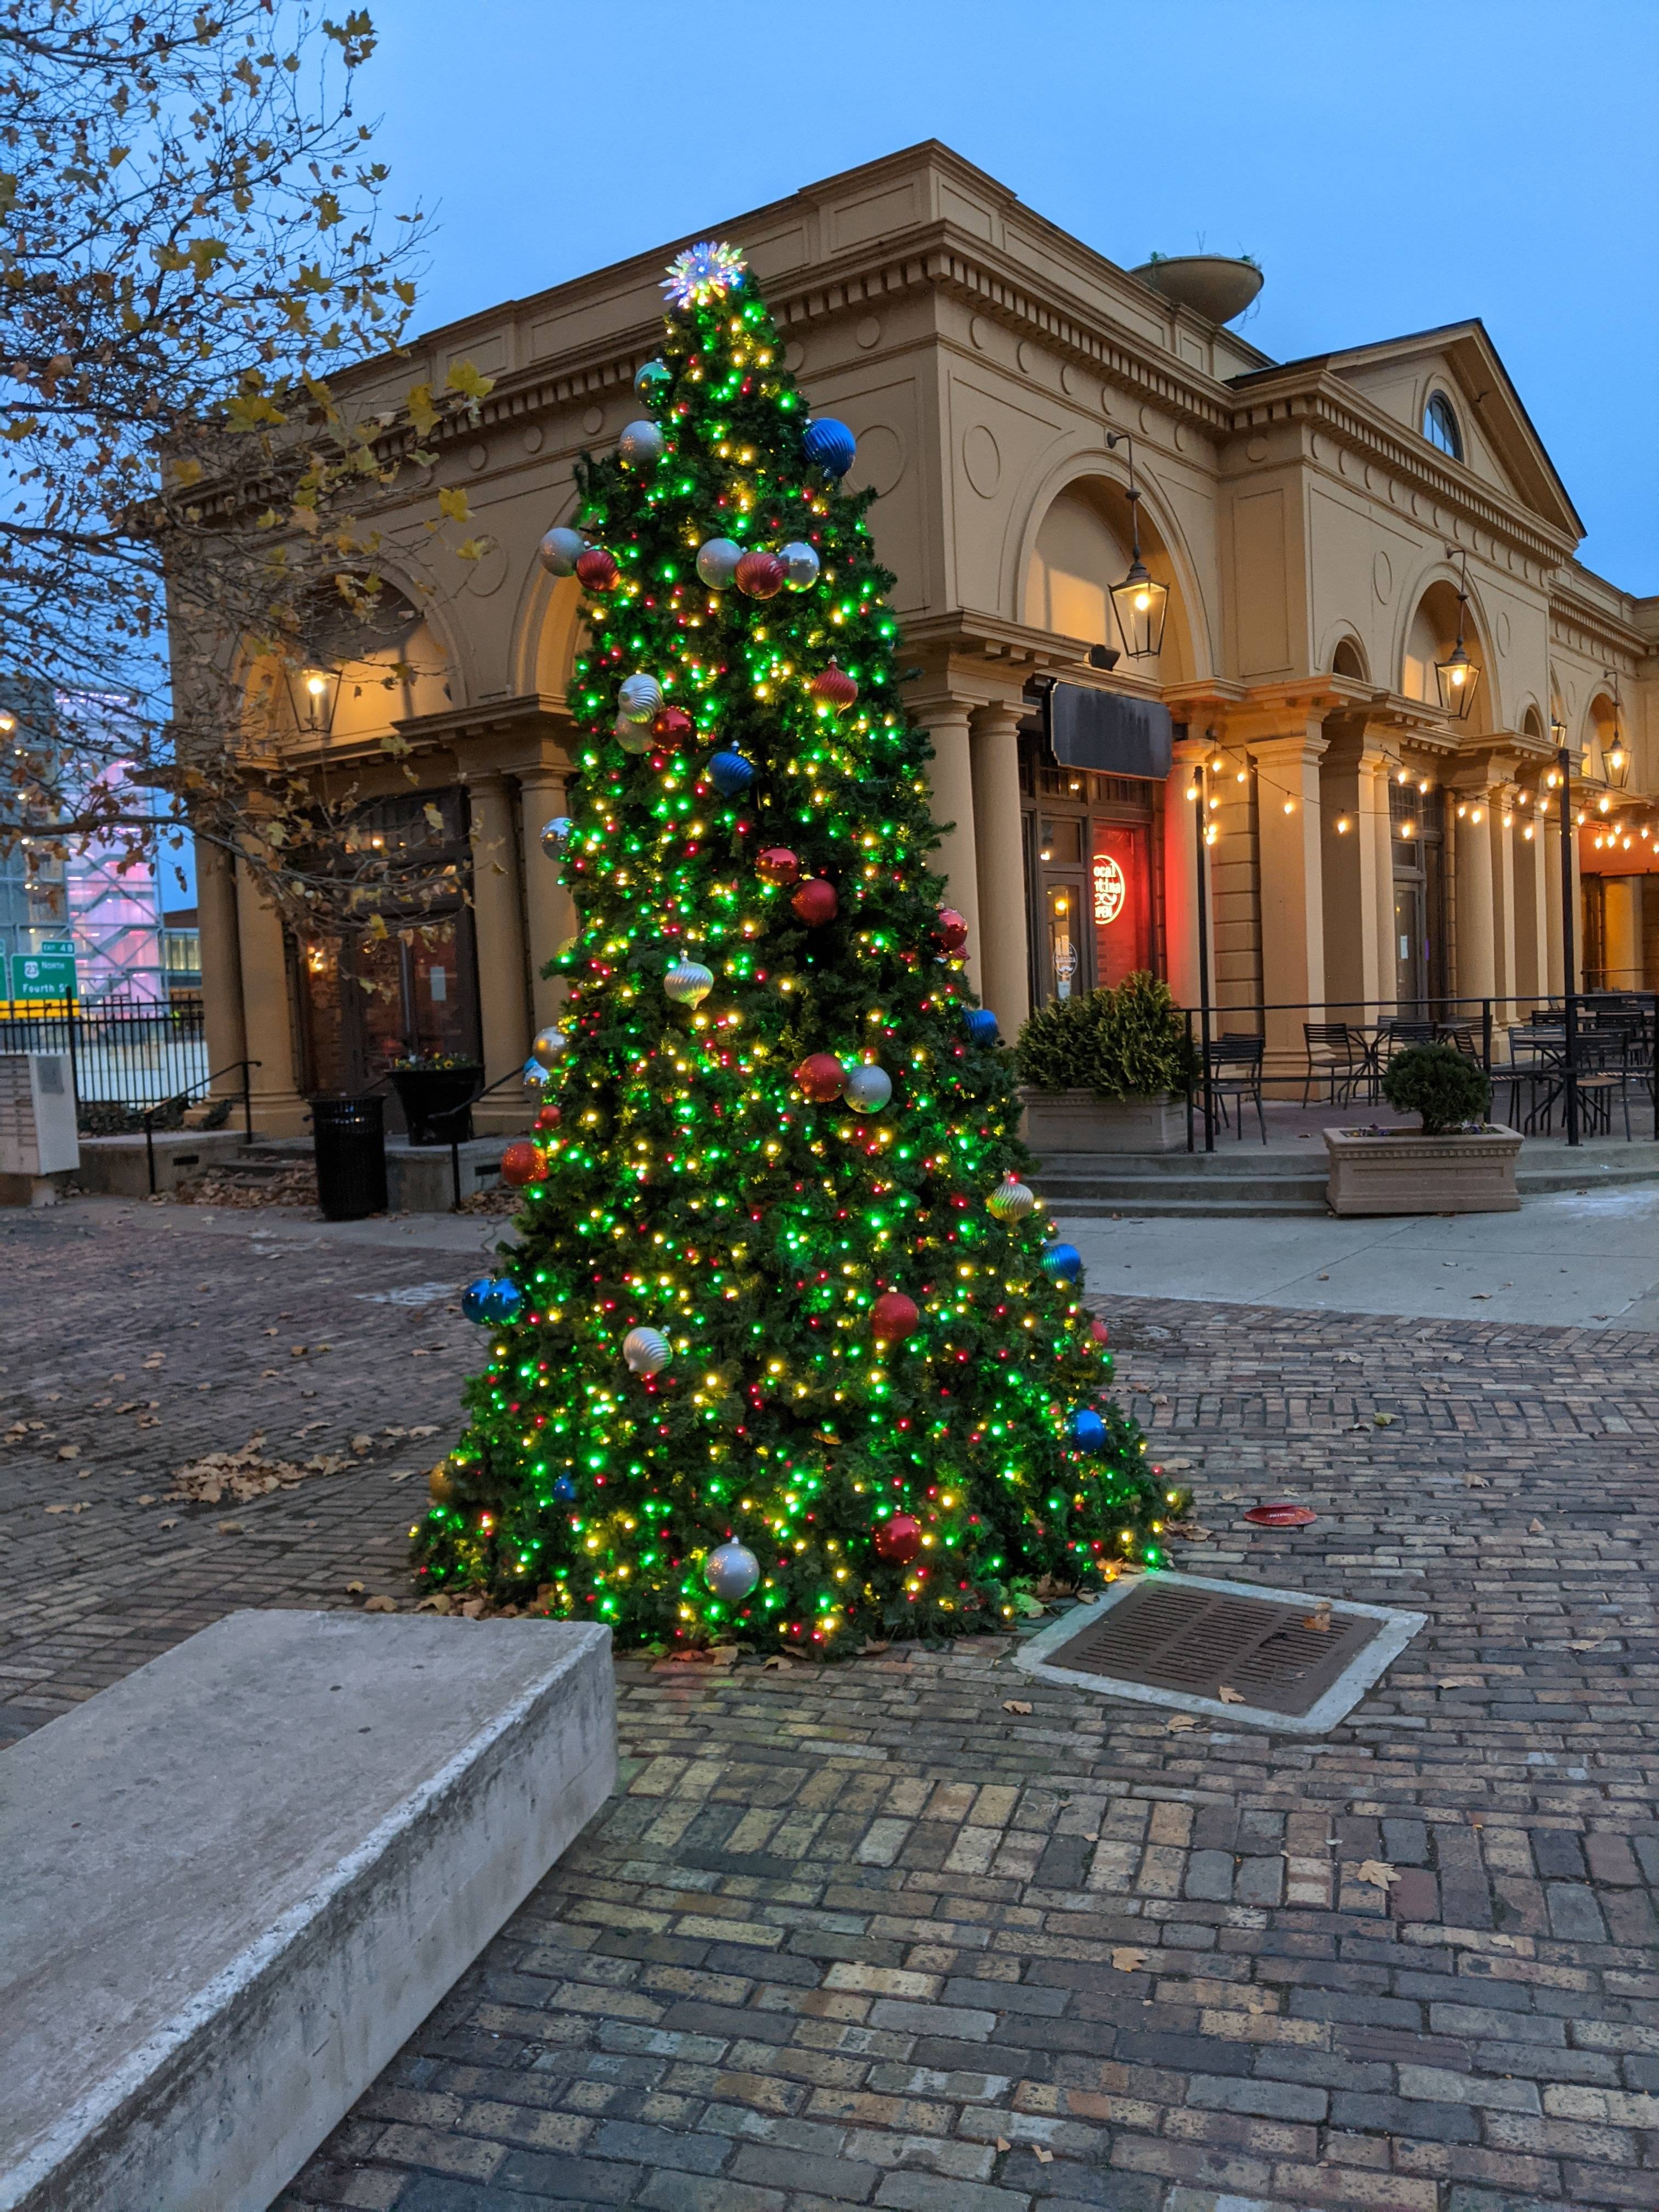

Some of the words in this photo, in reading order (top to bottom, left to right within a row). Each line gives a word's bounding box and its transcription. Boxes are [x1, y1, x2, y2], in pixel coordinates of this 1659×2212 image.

[1093, 863, 1116, 877] ocal
[1095, 906, 1113, 918] PEN
[26, 964, 37, 975] 23
[22, 983, 55, 993] Fourth
[58, 983, 69, 993] S
